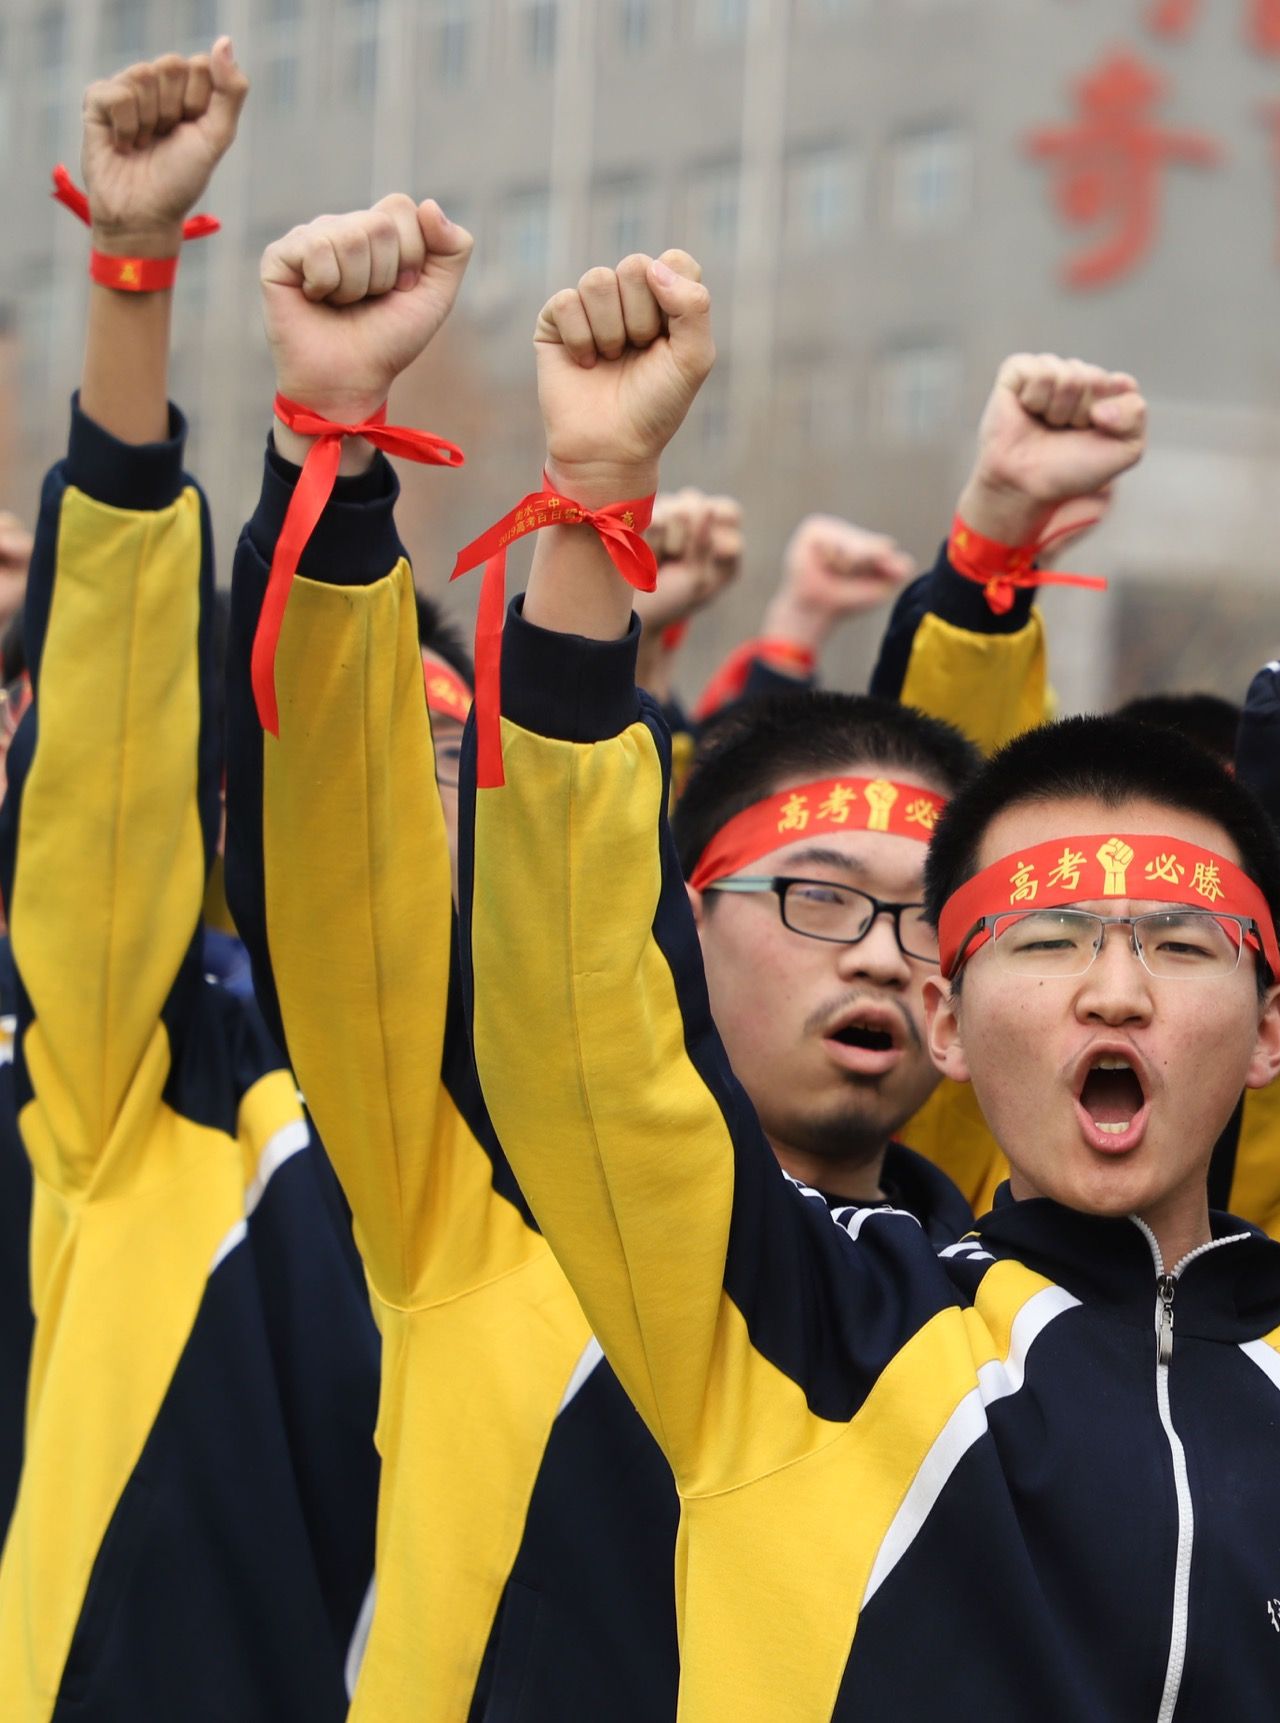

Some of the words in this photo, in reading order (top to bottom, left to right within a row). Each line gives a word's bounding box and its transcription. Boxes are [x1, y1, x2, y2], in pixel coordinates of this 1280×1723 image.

[777, 783, 857, 833] 高考
[904, 799, 940, 830] 必
[1009, 847, 1088, 905] 高考
[1145, 853, 1225, 902] 必勝
